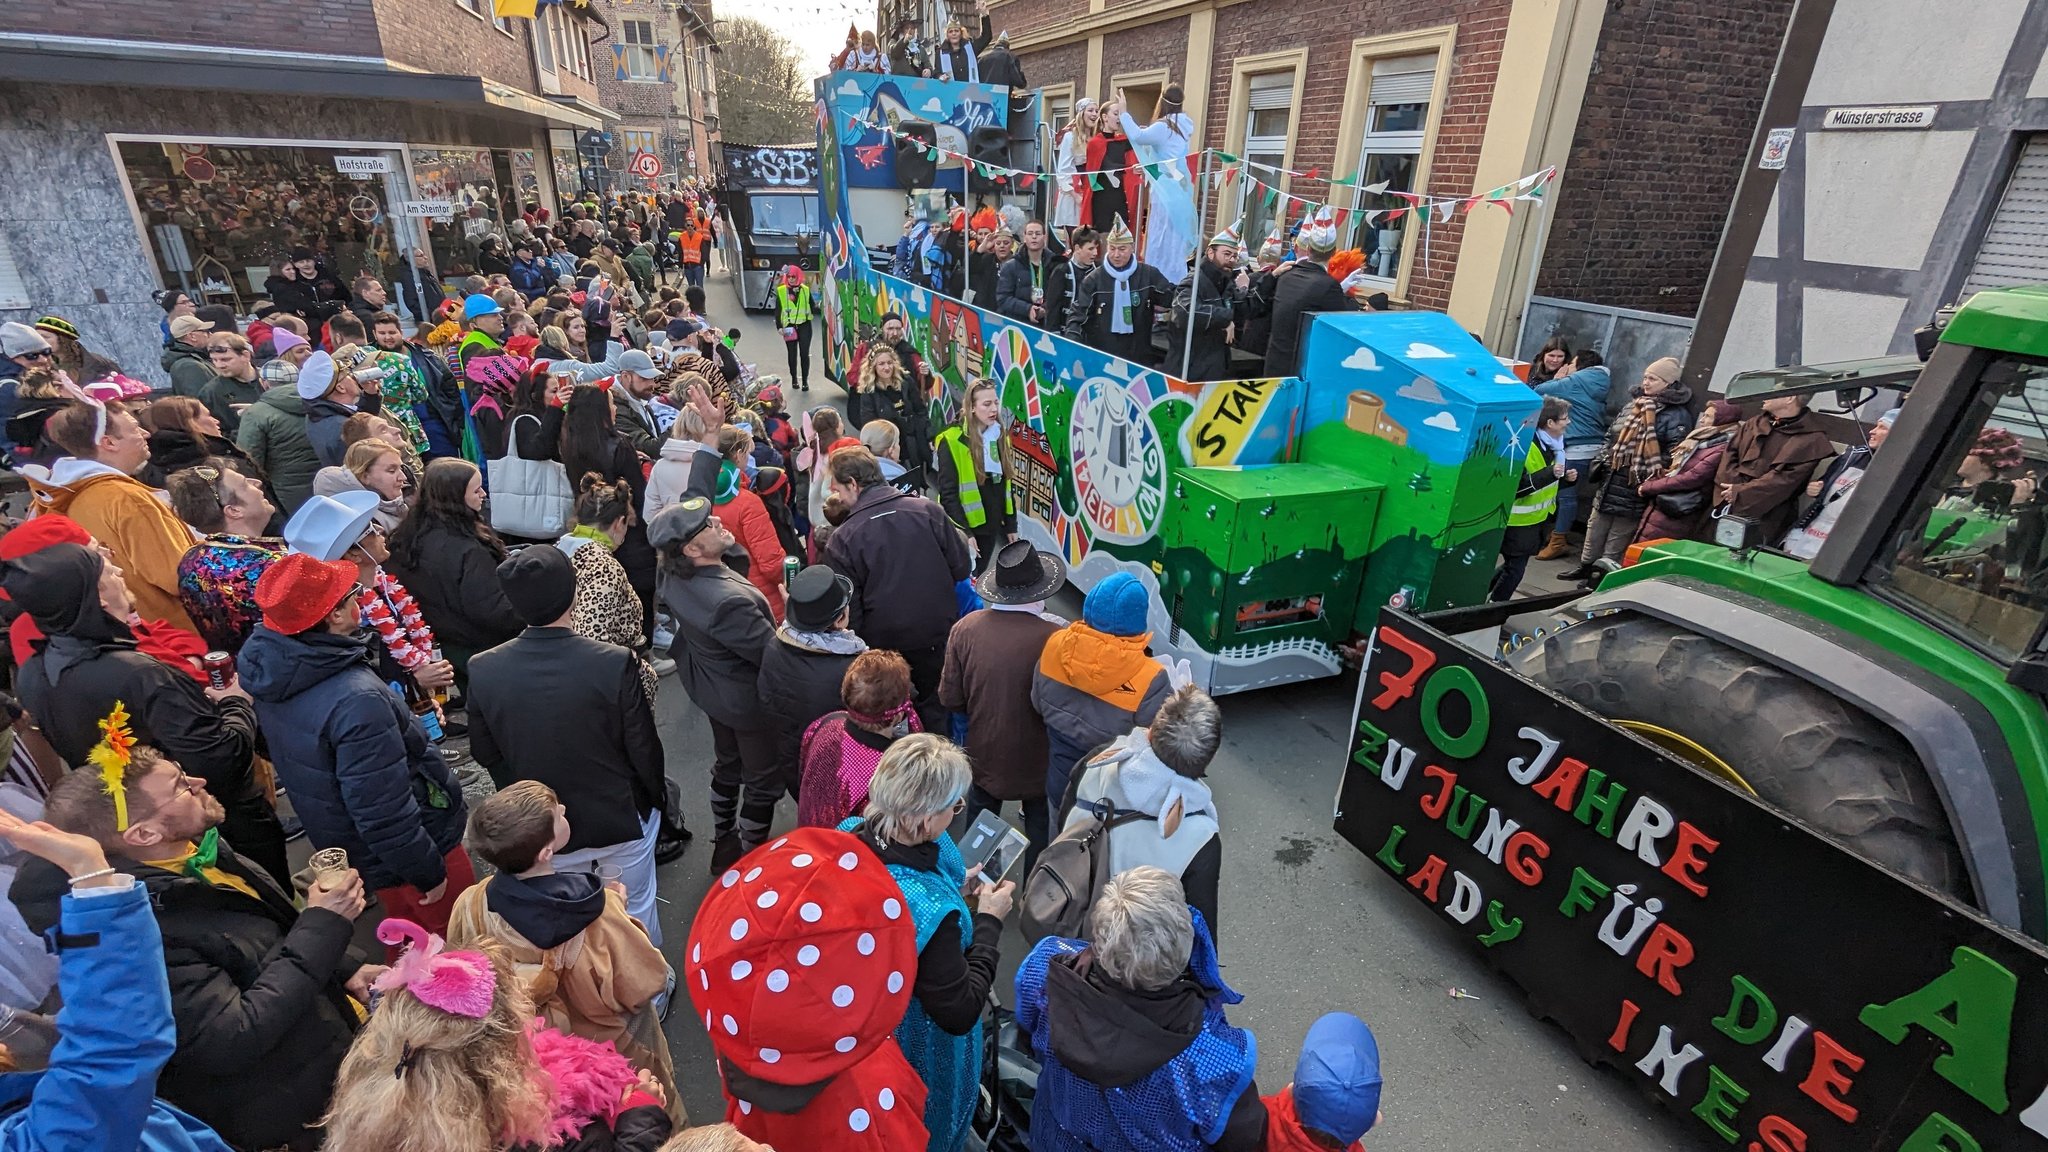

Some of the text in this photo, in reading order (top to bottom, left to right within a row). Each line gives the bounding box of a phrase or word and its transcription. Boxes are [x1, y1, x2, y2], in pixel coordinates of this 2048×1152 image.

[1832, 110, 1923, 125] Münsterstrasse
[339, 159, 384, 170] Hofstraße
[407, 204, 450, 214] Am Steintor
[1134, 413, 1145, 439] 8
[1144, 448, 1158, 477] 9
[1102, 504, 1113, 530] 2
[1371, 625, 1720, 897] 70 JAHRE
[1353, 720, 1865, 1123] ZU JUNG FÜR DIE
[1375, 825, 1808, 1152] LADY INES
